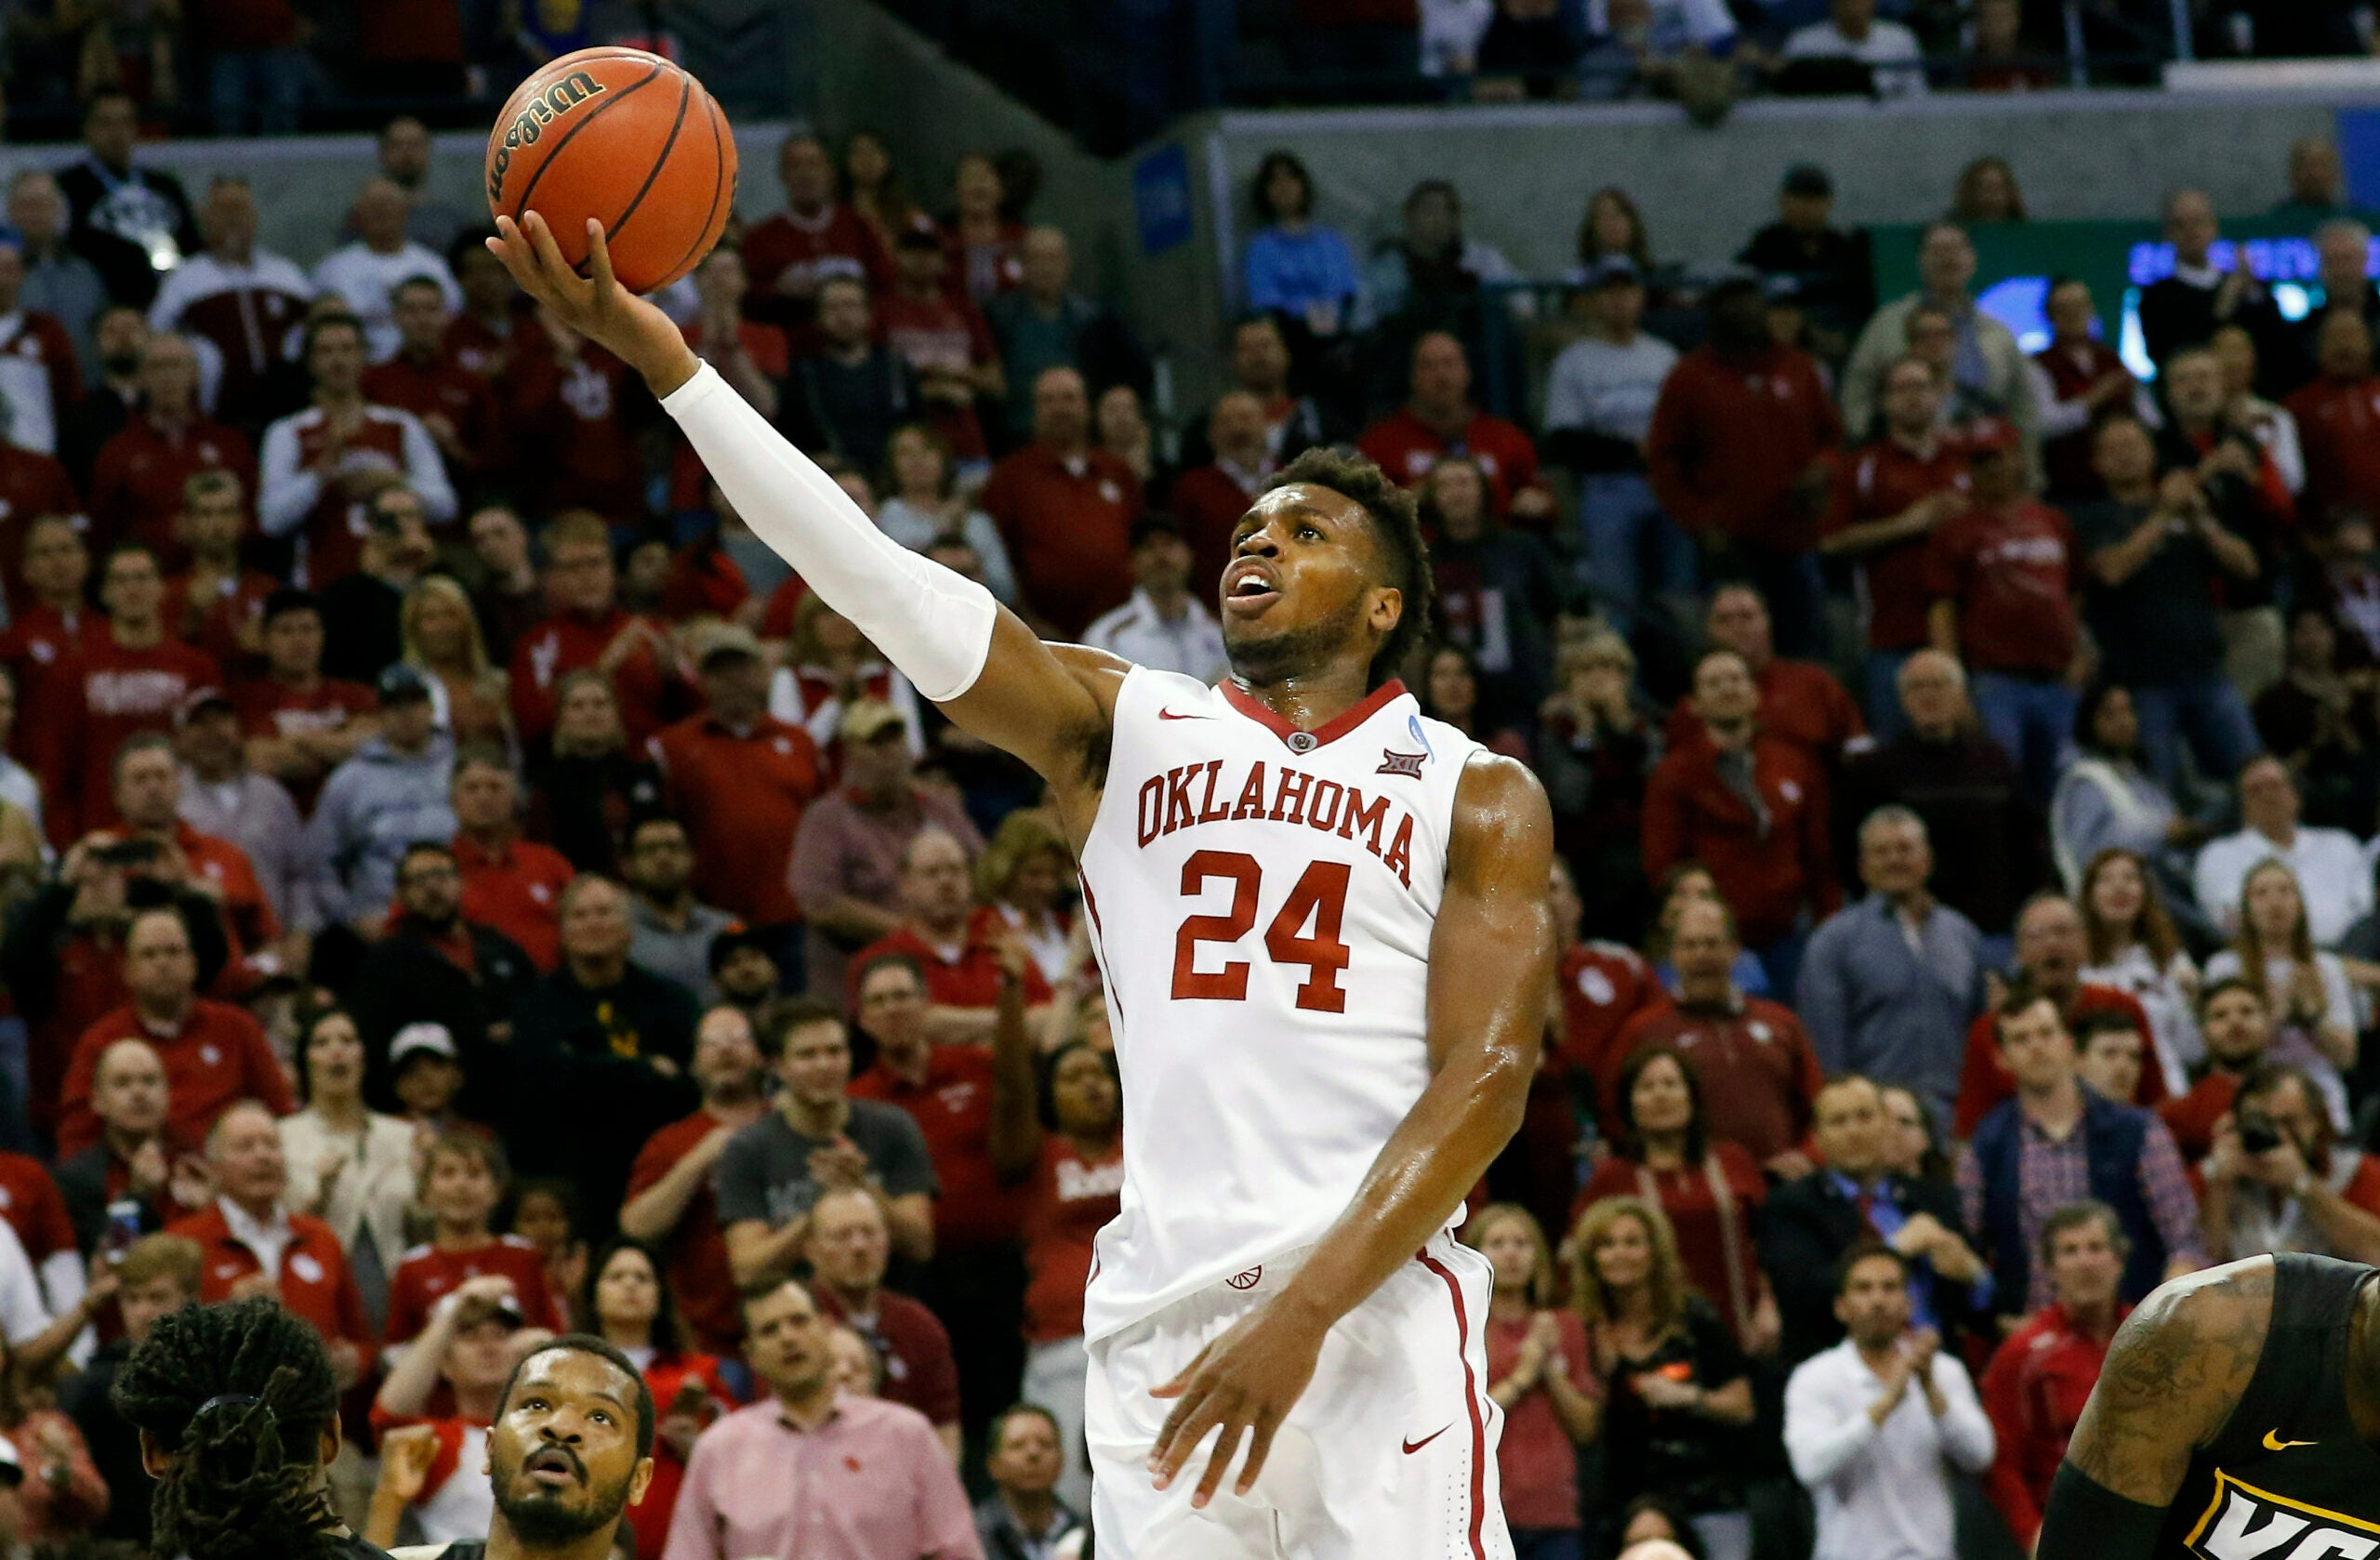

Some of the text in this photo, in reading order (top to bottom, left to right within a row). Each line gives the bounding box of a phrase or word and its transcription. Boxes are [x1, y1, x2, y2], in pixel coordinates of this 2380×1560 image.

[489, 72, 606, 203] Wilson
[1138, 759, 1414, 891] OKLAHOMA
[1375, 748, 1428, 781] XII
[1170, 849, 1352, 1013] 24
